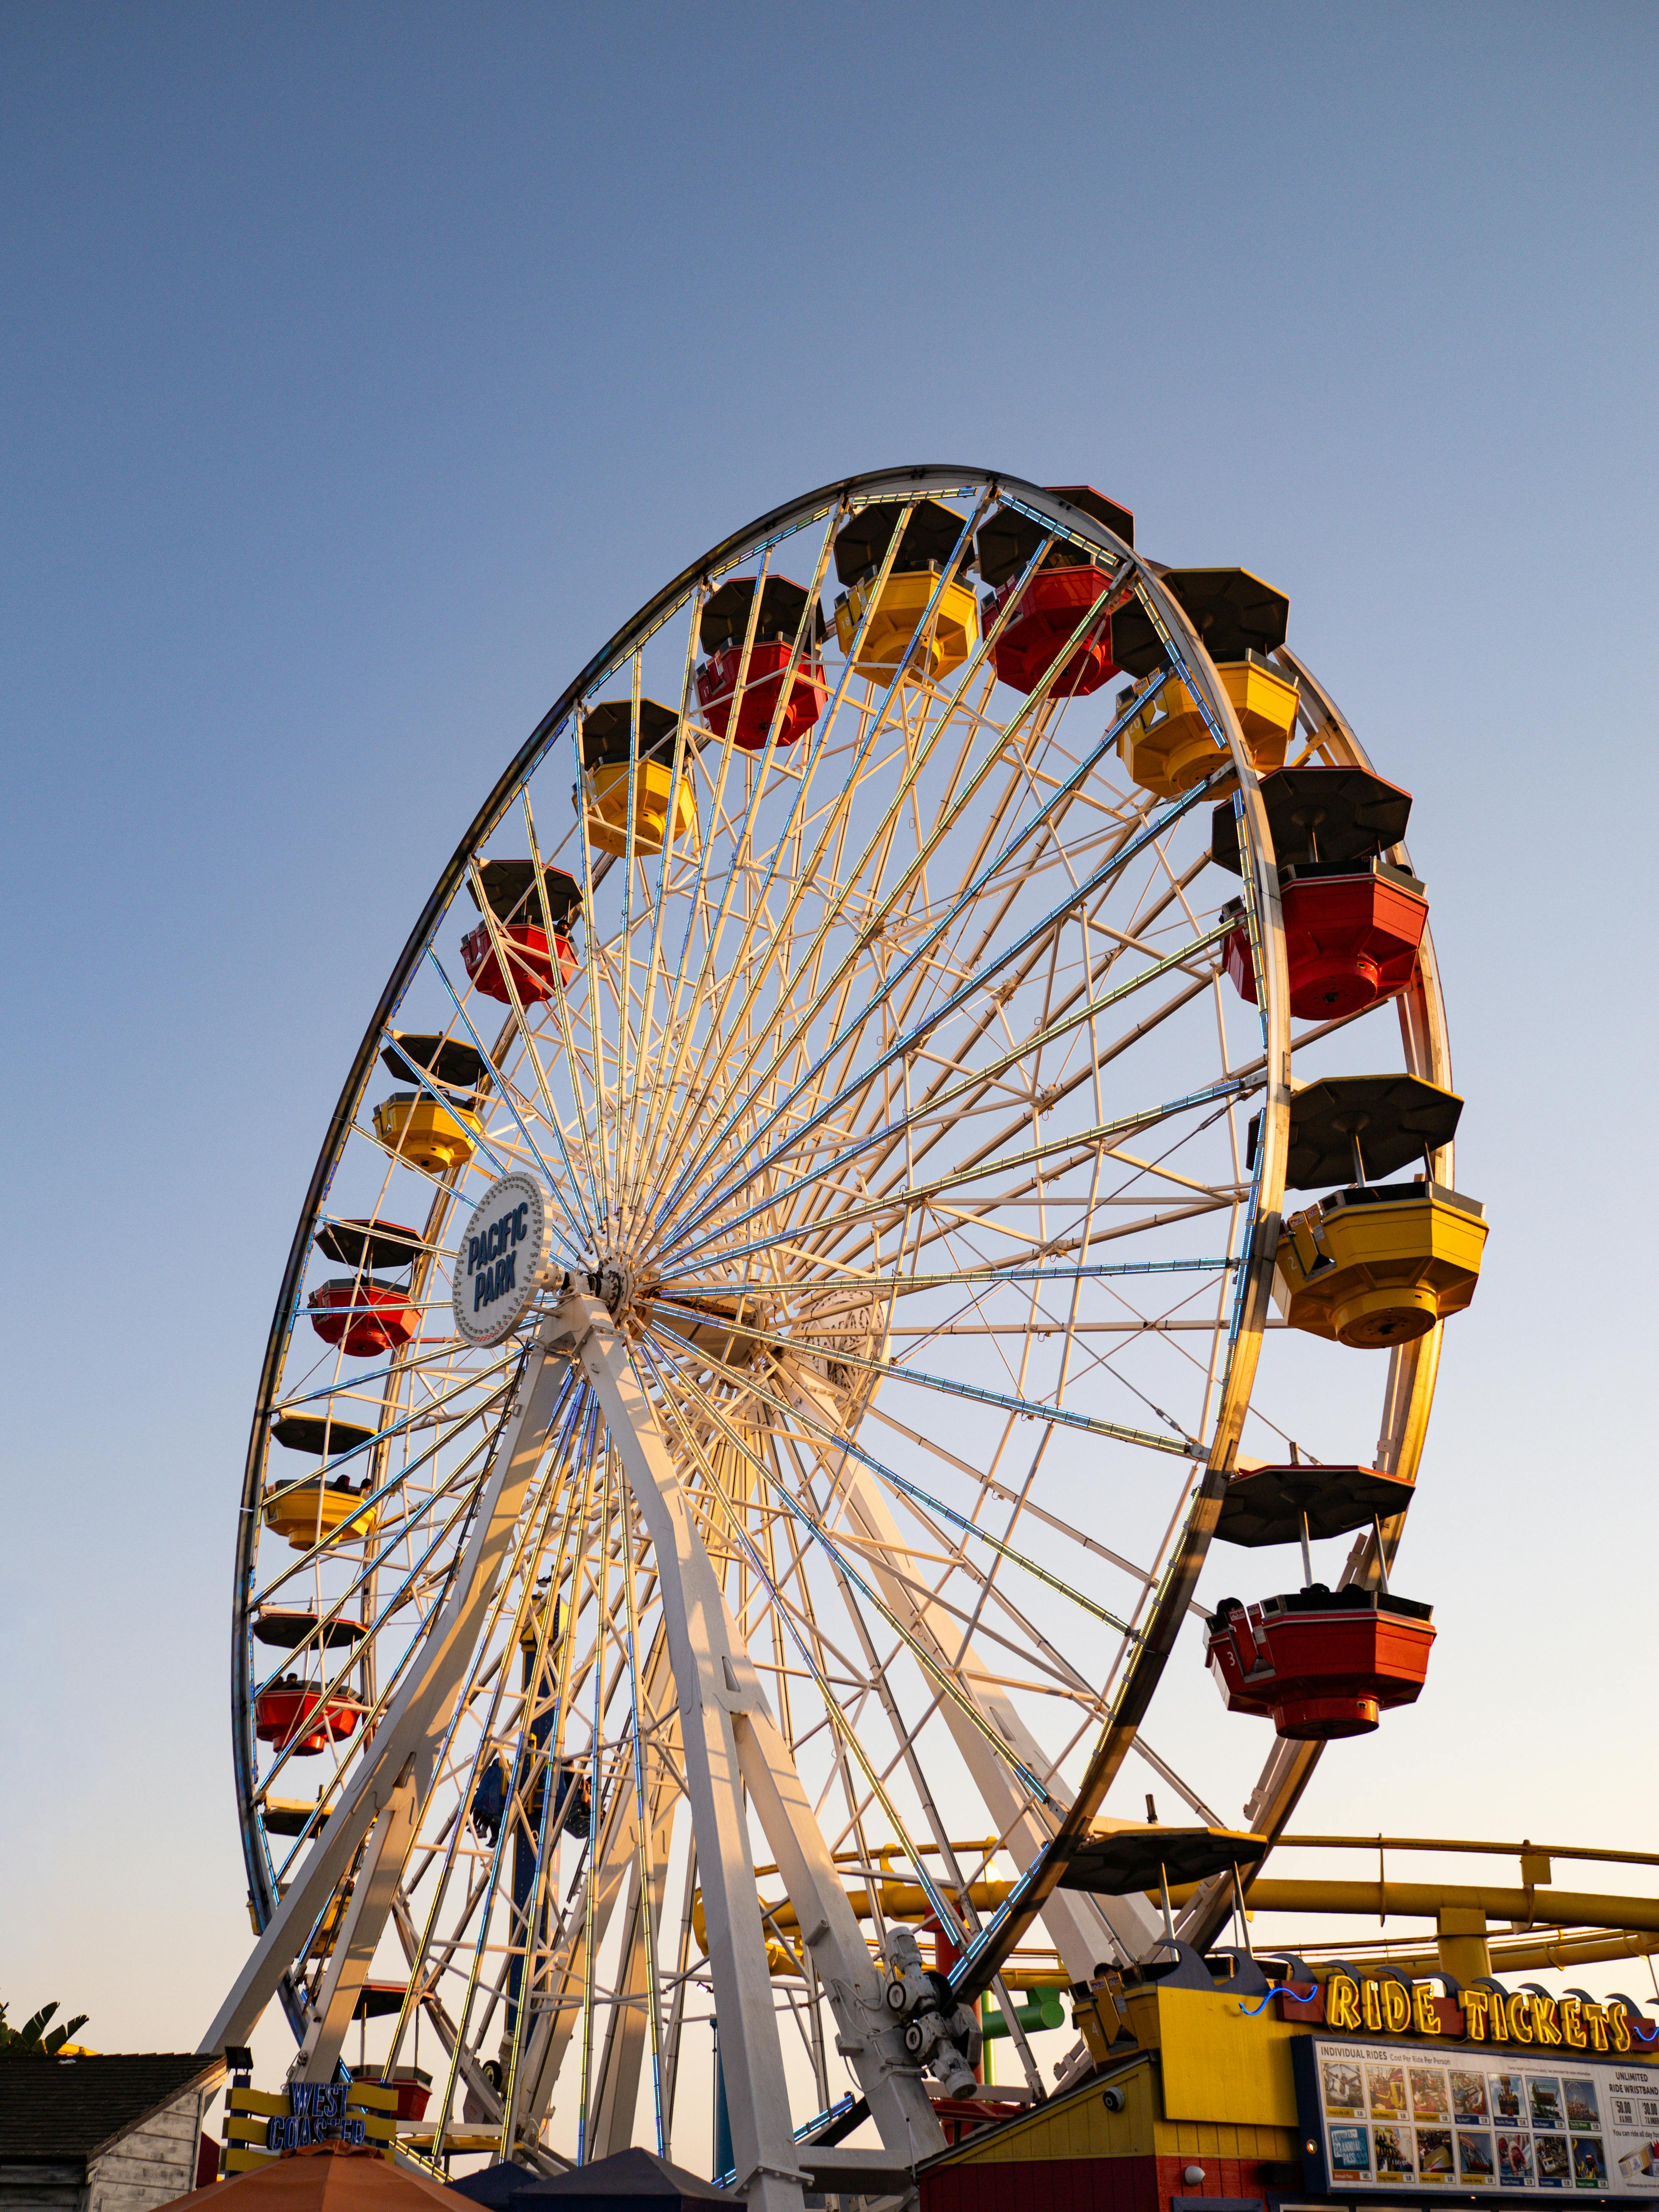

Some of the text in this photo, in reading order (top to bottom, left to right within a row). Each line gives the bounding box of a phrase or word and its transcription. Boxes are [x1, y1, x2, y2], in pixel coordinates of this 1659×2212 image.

[842, 616, 850, 629] 18
[704, 685, 709, 697] 17
[466, 955, 470, 965] 15
[467, 1202, 528, 1275] PACIFIC
[1287, 1256, 1297, 1270] 2
[474, 1250, 516, 1312] PARK
[1227, 1651, 1236, 1667] 3
[1329, 1975, 1631, 2052] RIDE TICKETS
[1092, 2022, 1099, 2037] 4
[1321, 2046, 1365, 2058] INDIVIDUAL
[1366, 2050, 1387, 2060] RIDES
[1433, 2057, 1450, 2065] Person
[1615, 2072, 1648, 2082] UNLIMITED
[1609, 2084, 1659, 2095] RIDE WRISTBAND
[292, 2082, 352, 2118] WEST
[1344, 2153, 1356, 2164] PASS
